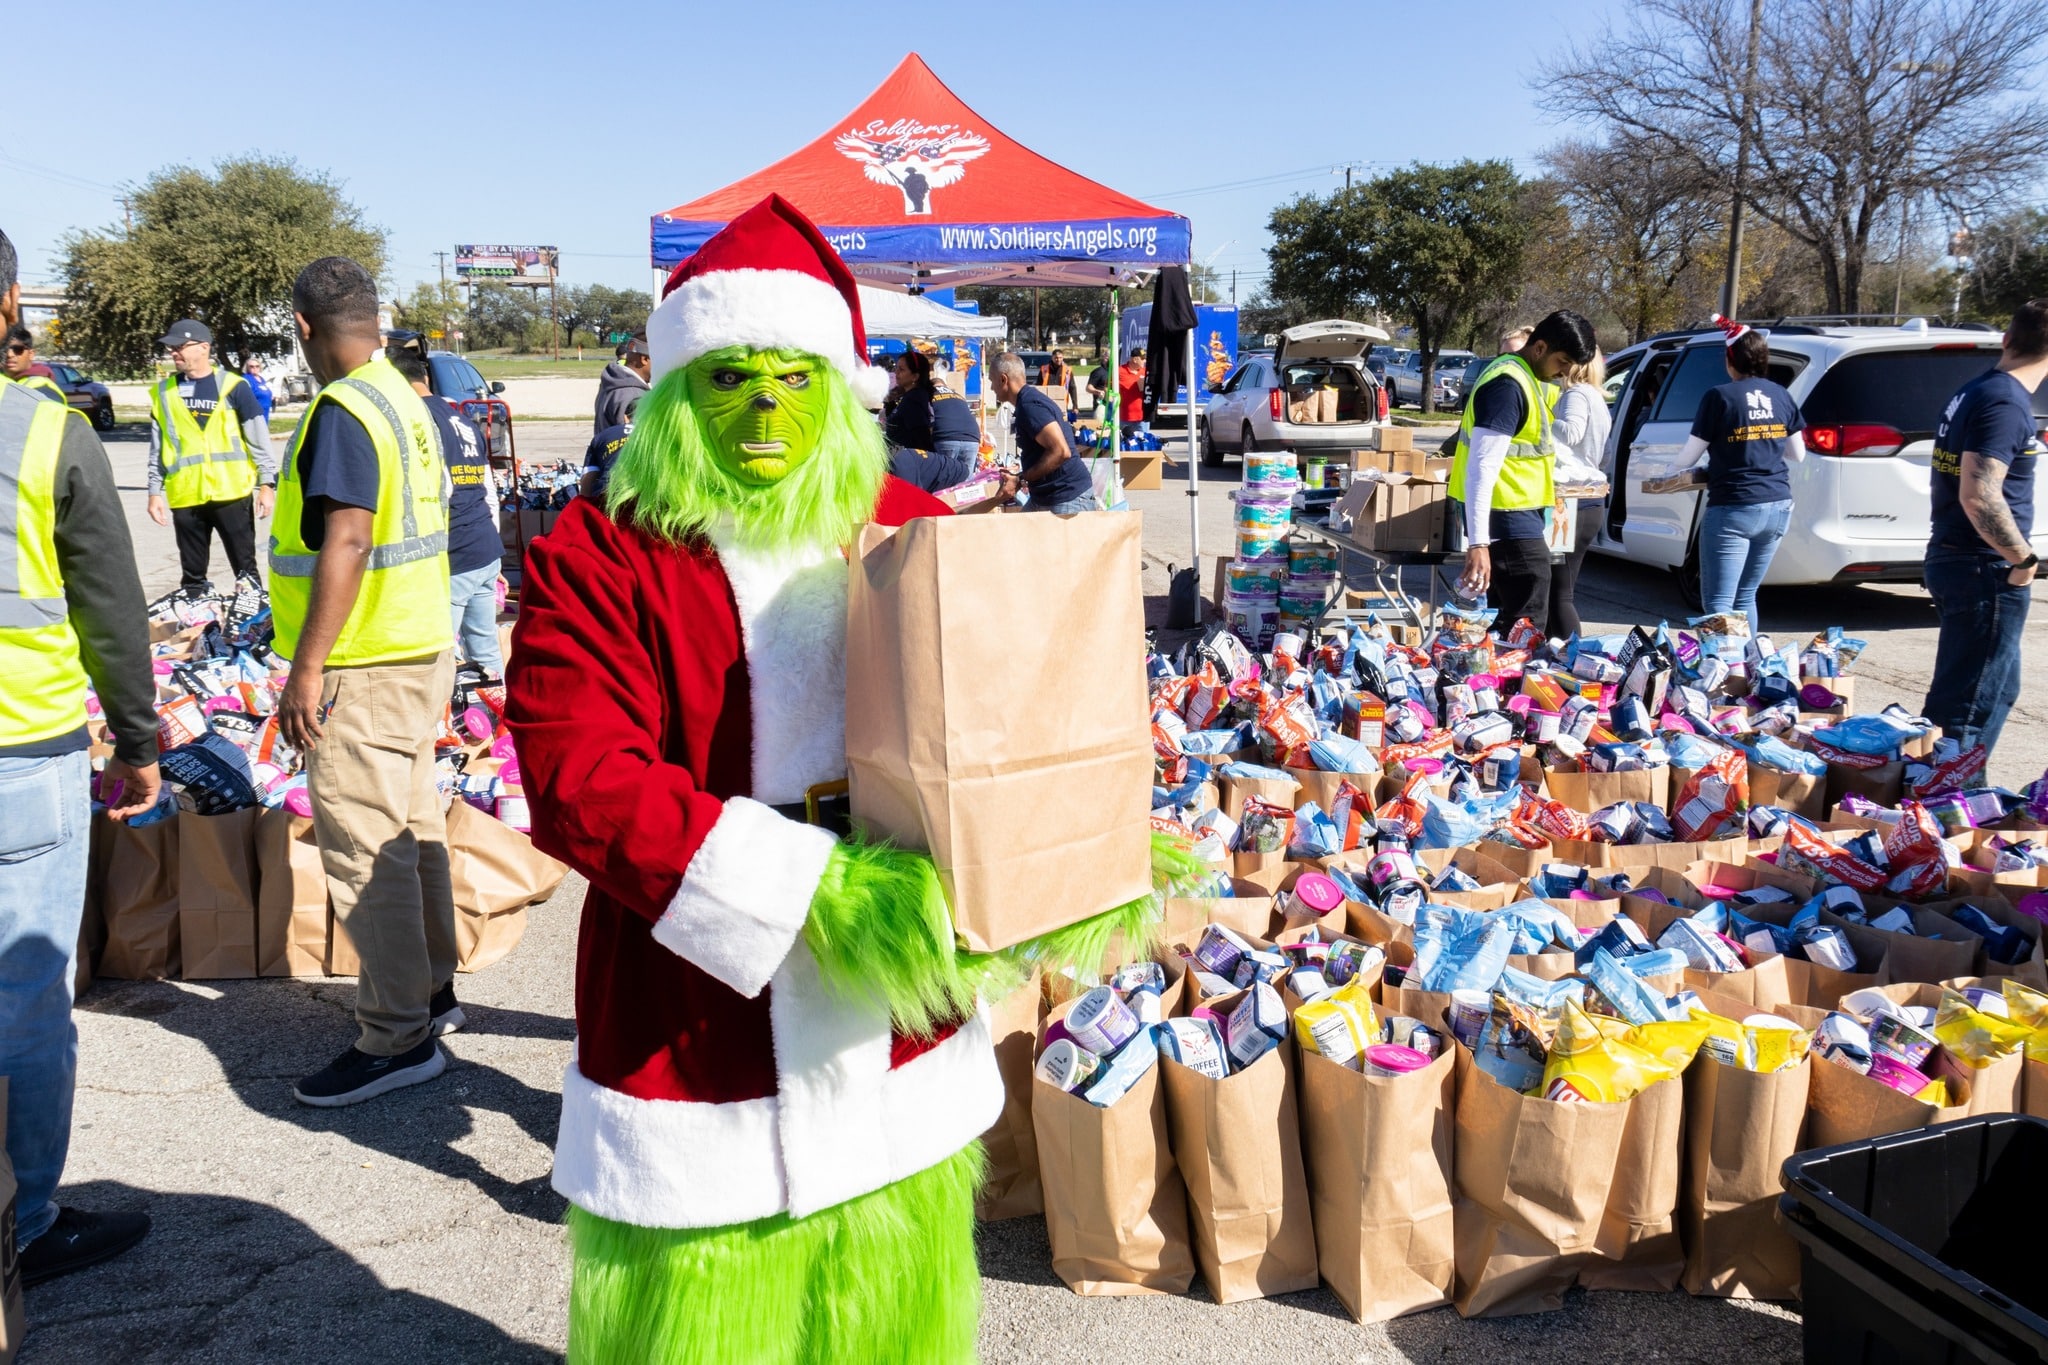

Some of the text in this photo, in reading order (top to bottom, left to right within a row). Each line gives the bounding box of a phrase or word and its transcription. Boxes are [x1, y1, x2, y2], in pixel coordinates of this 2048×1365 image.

[882, 130, 962, 150] Angels
[1748, 408, 1775, 421] USAA
[175, 758, 202, 778] HELPS
[1800, 840, 1833, 869] 73%
[1831, 862, 1851, 878] LOCAL
[1721, 1053, 1735, 1061] 160
